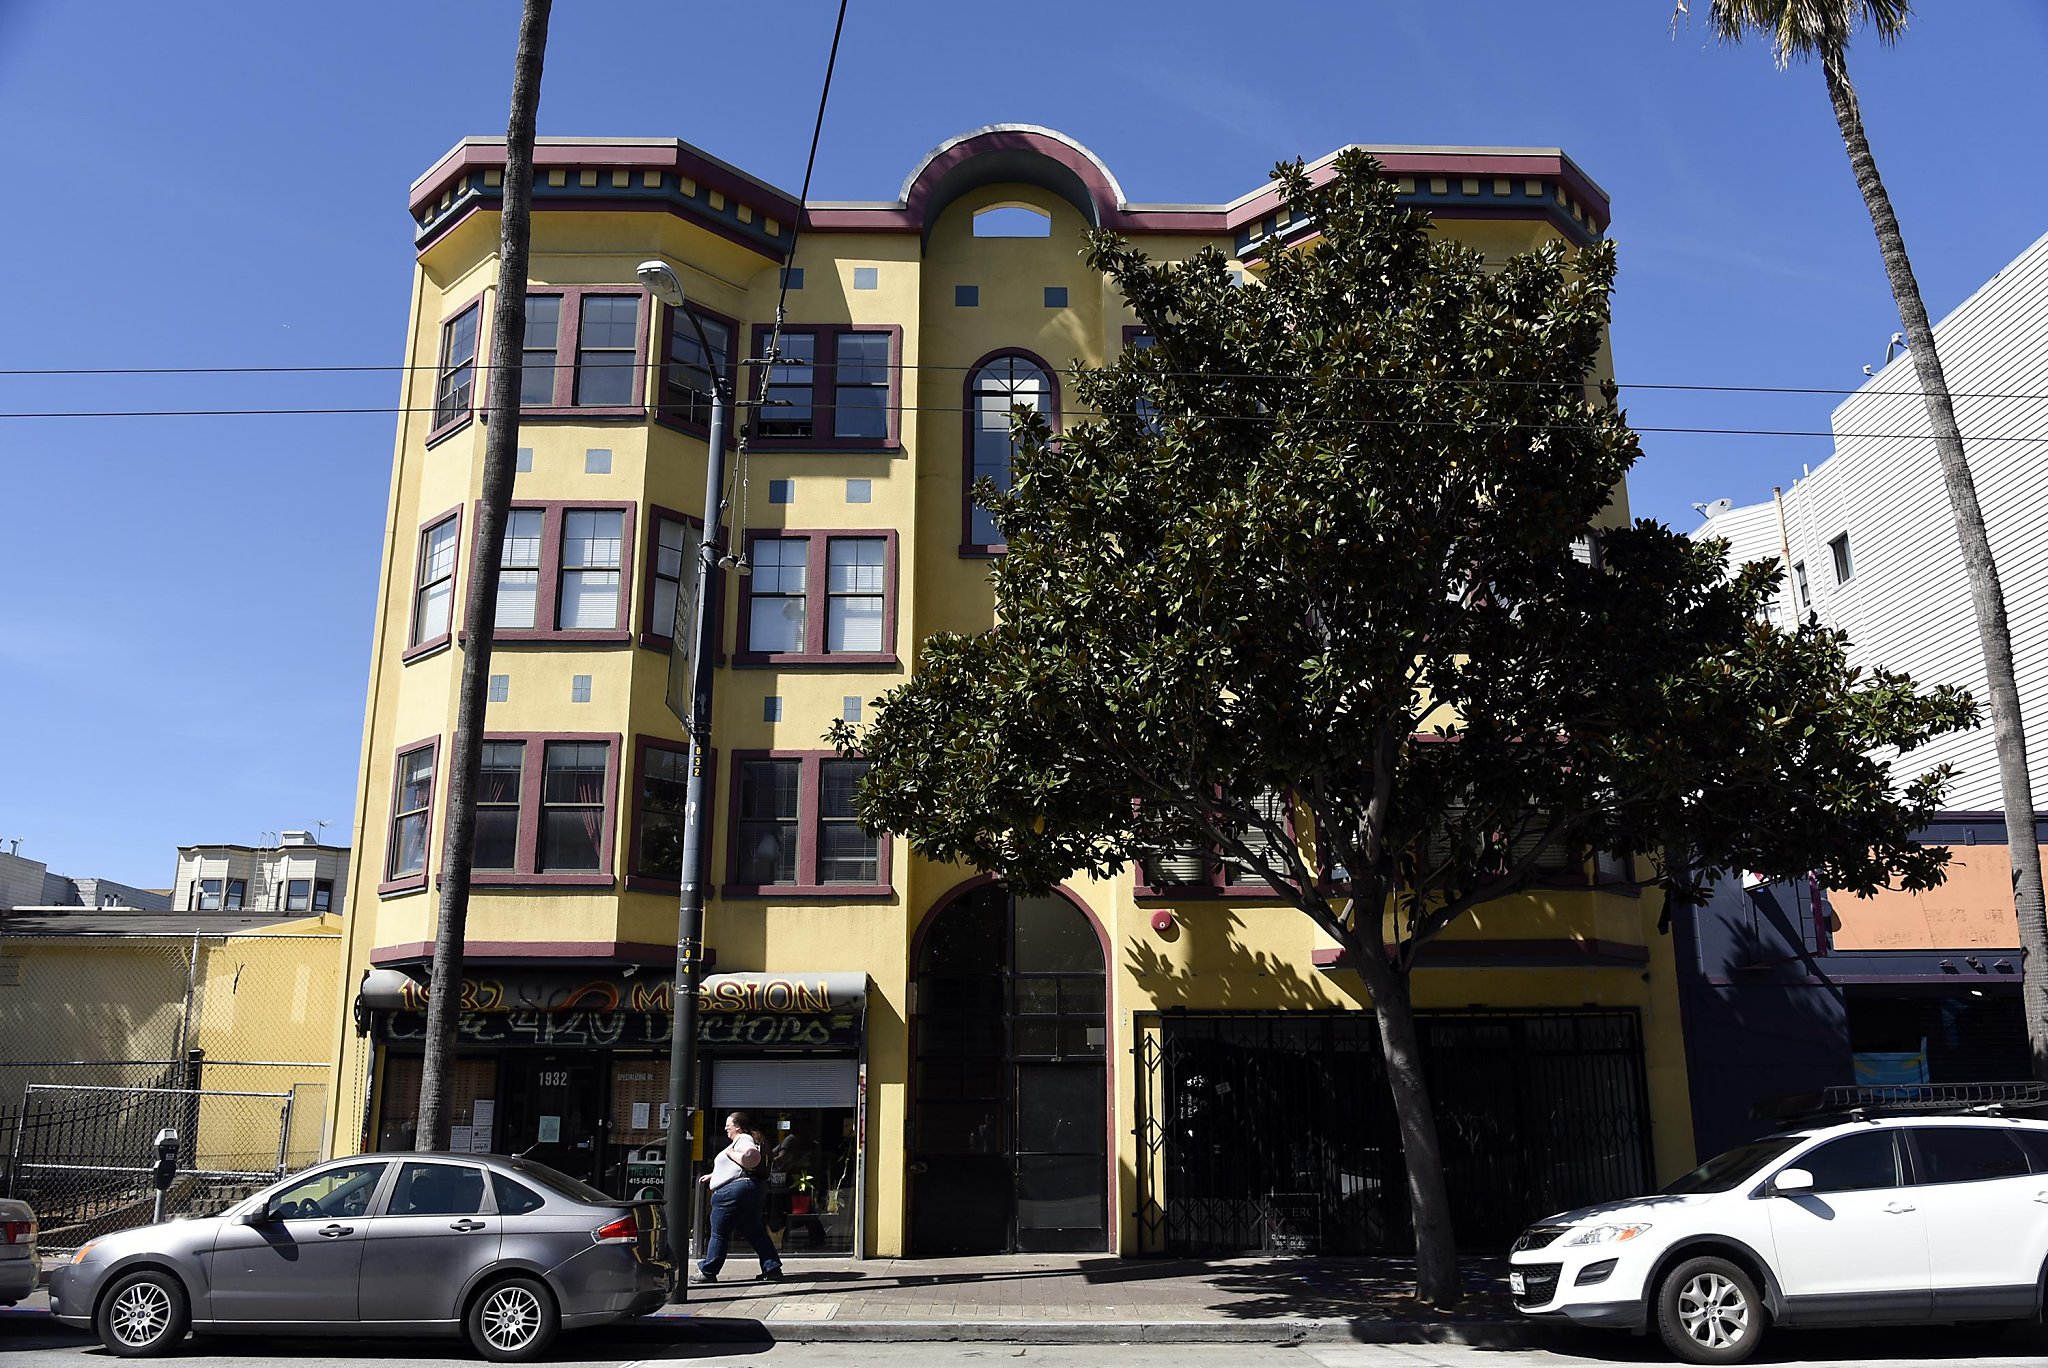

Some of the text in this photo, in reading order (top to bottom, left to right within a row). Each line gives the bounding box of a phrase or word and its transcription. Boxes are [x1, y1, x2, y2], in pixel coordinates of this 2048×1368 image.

[632, 979, 832, 1013] MSSION
[638, 1013, 829, 1044] Dctors
[538, 1071, 568, 1086] 1932
[645, 1167, 666, 1177] DOCT
